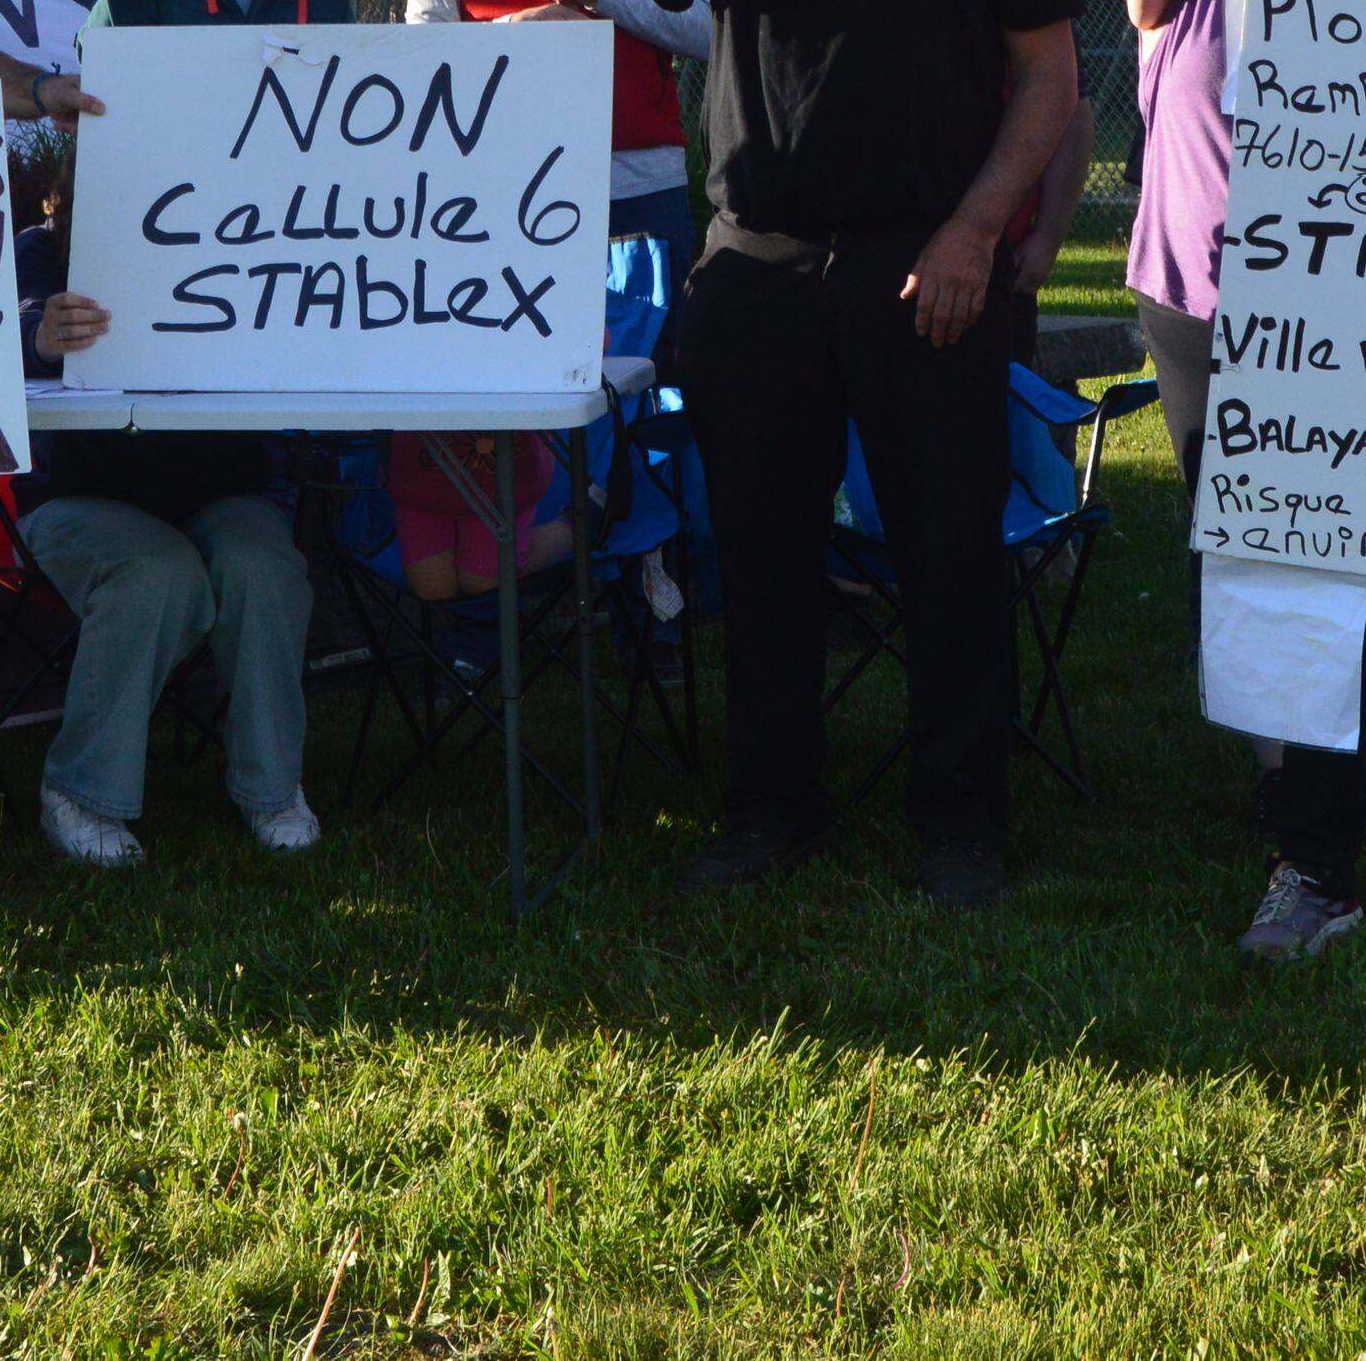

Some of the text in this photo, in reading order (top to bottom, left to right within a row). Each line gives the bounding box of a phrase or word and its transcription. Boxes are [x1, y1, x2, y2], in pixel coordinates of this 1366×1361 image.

[229, 54, 509, 159] NON
[517, 146, 582, 246] 6
[1221, 312, 1341, 373] Ville
[1211, 473, 1351, 528] Risque
